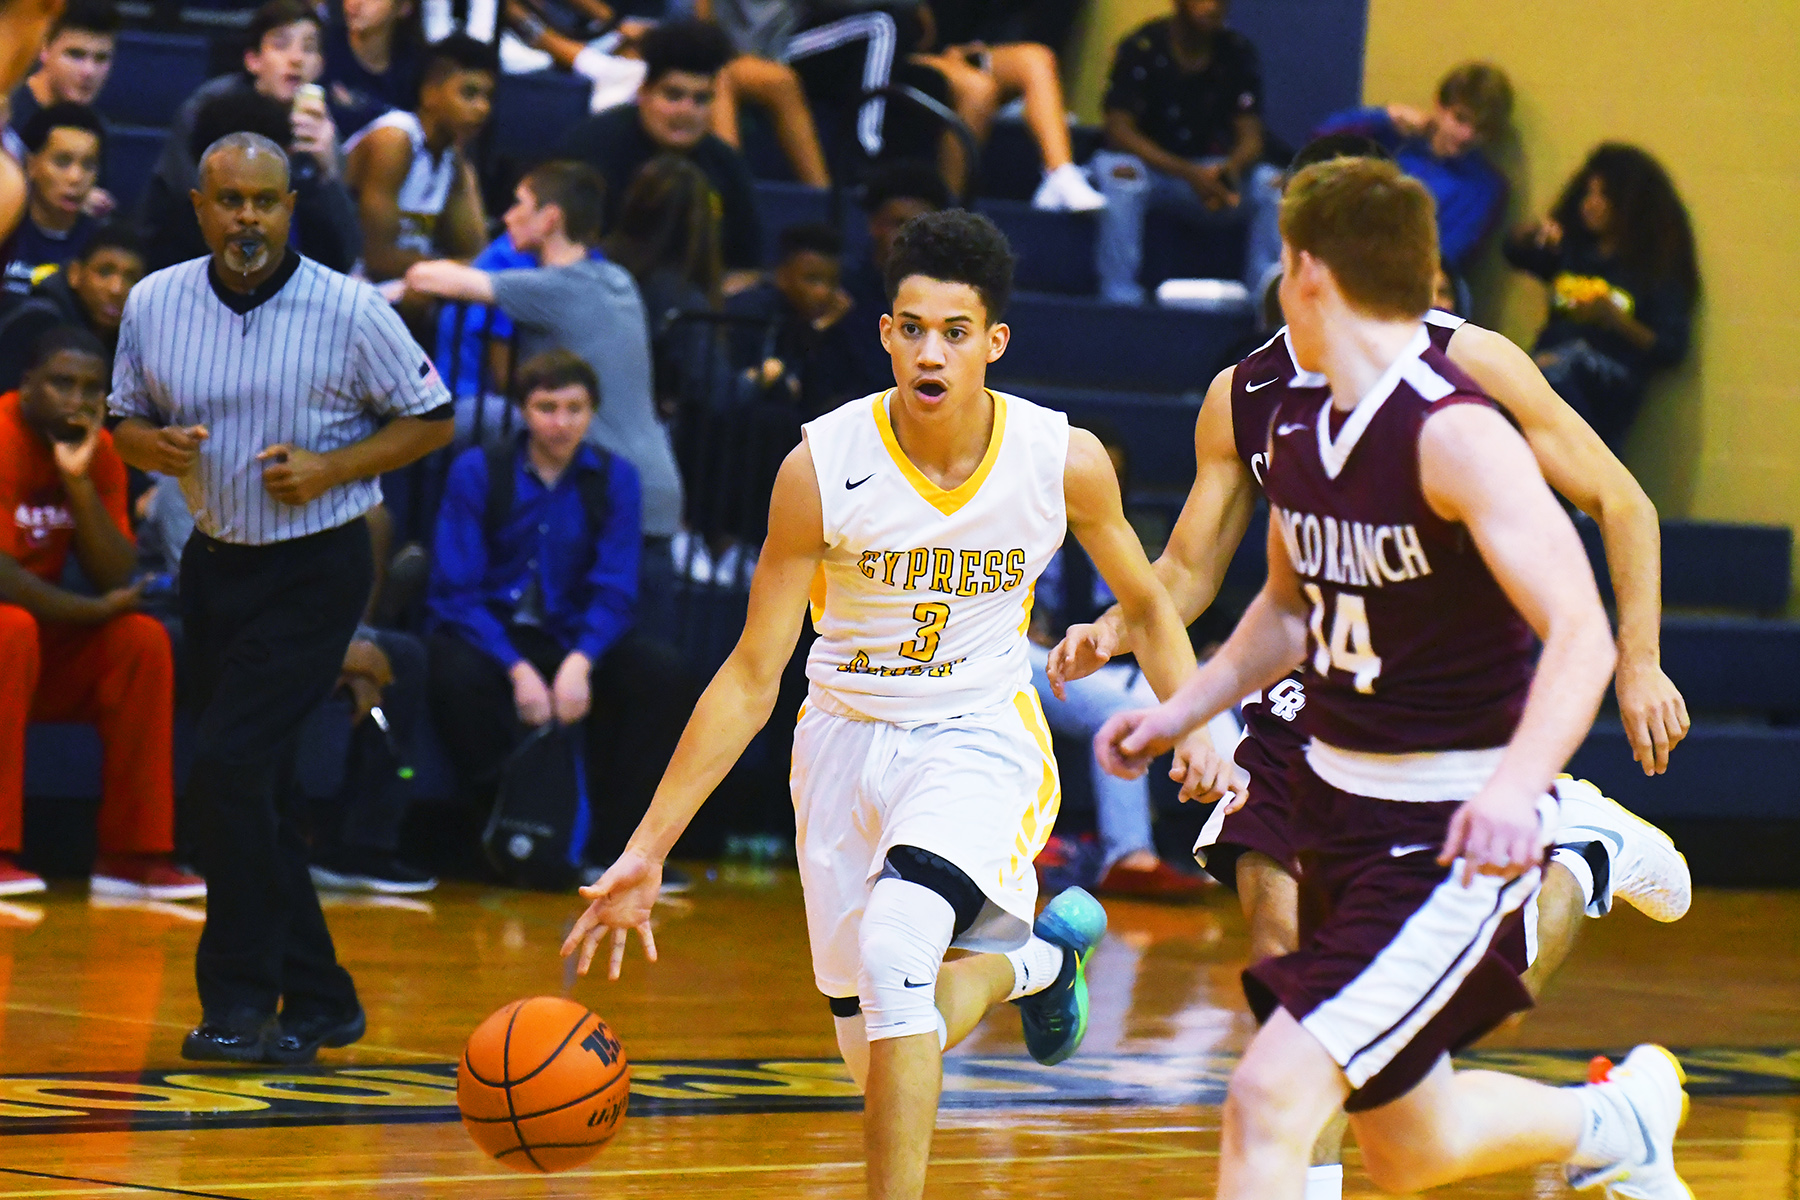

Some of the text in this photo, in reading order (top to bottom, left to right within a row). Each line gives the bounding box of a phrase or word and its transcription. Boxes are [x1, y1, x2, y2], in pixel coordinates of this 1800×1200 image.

[857, 547, 1025, 597] CYPRESS
[1324, 515, 1433, 588] RANCH
[899, 602, 951, 662] 3
[1304, 582, 1382, 695] 14
